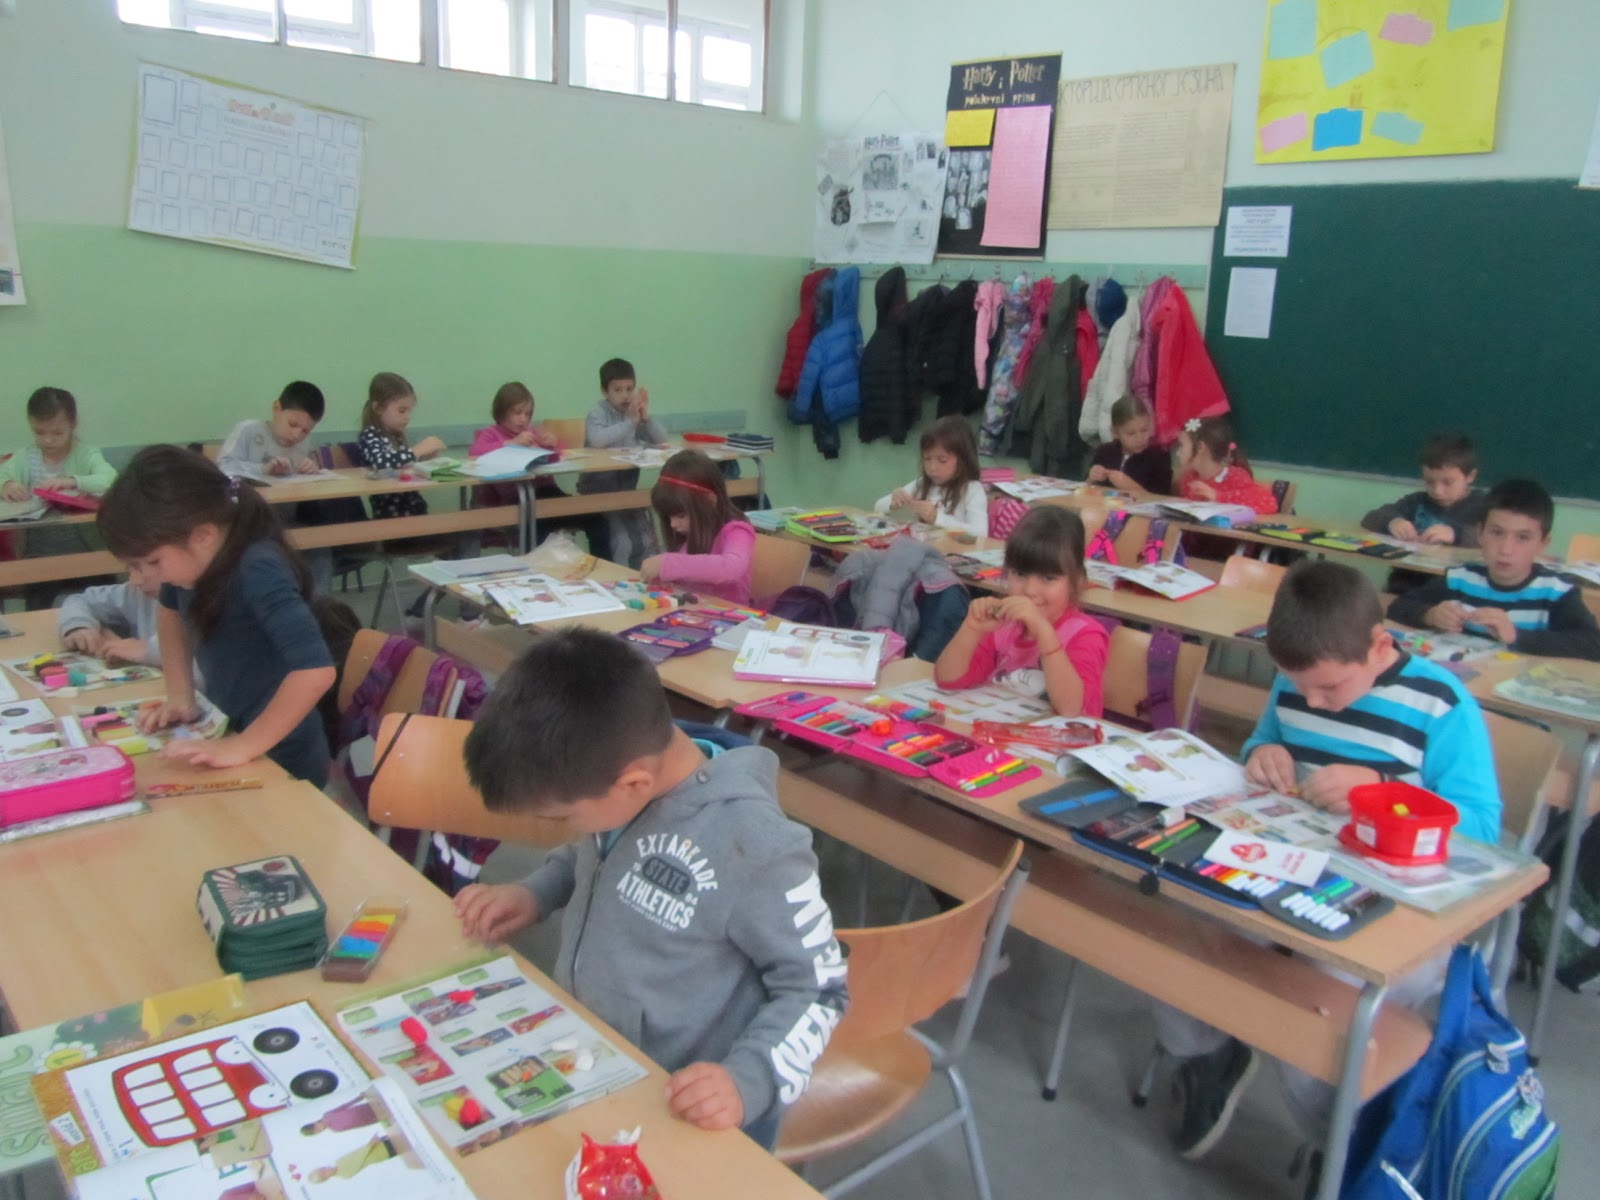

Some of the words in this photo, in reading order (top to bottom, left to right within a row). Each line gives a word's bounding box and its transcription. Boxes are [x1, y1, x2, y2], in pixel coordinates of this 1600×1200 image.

[963, 65, 997, 91] Harry
[999, 77, 1004, 90] i
[1009, 60, 1045, 90] Potter
[1058, 79, 1112, 105] СТОРИЈА
[645, 859, 688, 894] STATE
[616, 871, 695, 928] ATHLETICS
